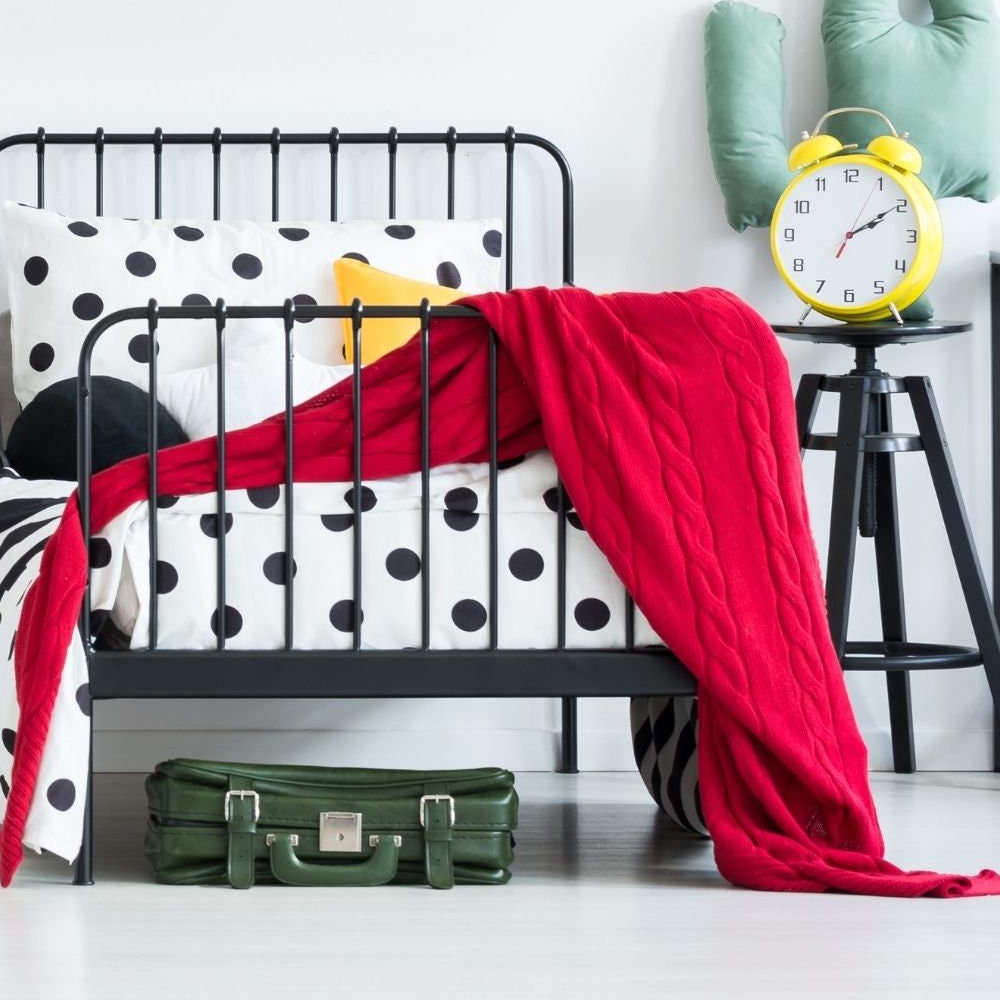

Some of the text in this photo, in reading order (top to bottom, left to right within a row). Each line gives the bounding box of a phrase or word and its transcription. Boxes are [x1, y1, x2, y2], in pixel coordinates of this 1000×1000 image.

[844, 169, 859, 183] 12
[816, 178, 826, 192] 11
[878, 177, 883, 191] 1
[794, 200, 810, 214] 10
[896, 199, 907, 213] 2
[784, 228, 795, 242] 9
[906, 230, 917, 243] 3
[793, 259, 804, 272] 8
[895, 260, 906, 273] 4
[816, 280, 825, 293] 7
[874, 281, 884, 294] 5
[844, 290, 854, 302] 6
